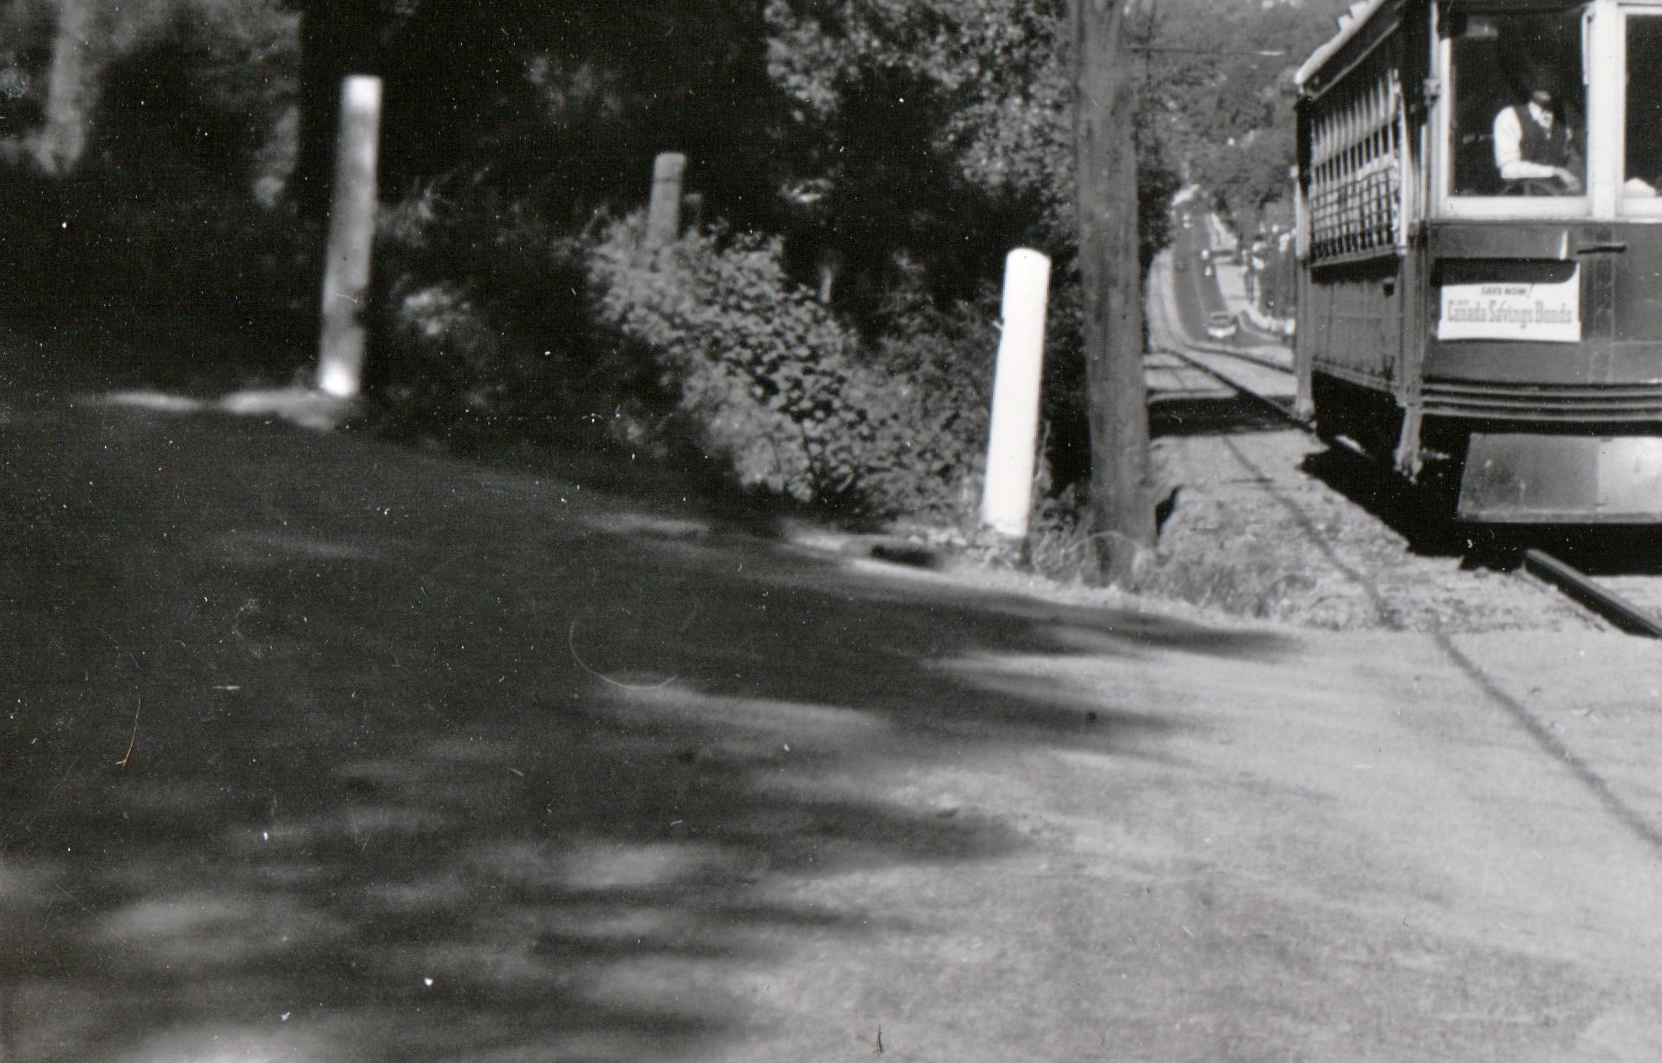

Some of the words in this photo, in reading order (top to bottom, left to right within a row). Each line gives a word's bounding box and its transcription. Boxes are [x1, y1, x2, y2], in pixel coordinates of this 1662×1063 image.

[1447, 299, 1487, 323] Canada
[1489, 299, 1534, 329] Savings
[1535, 300, 1573, 324] Bonds
